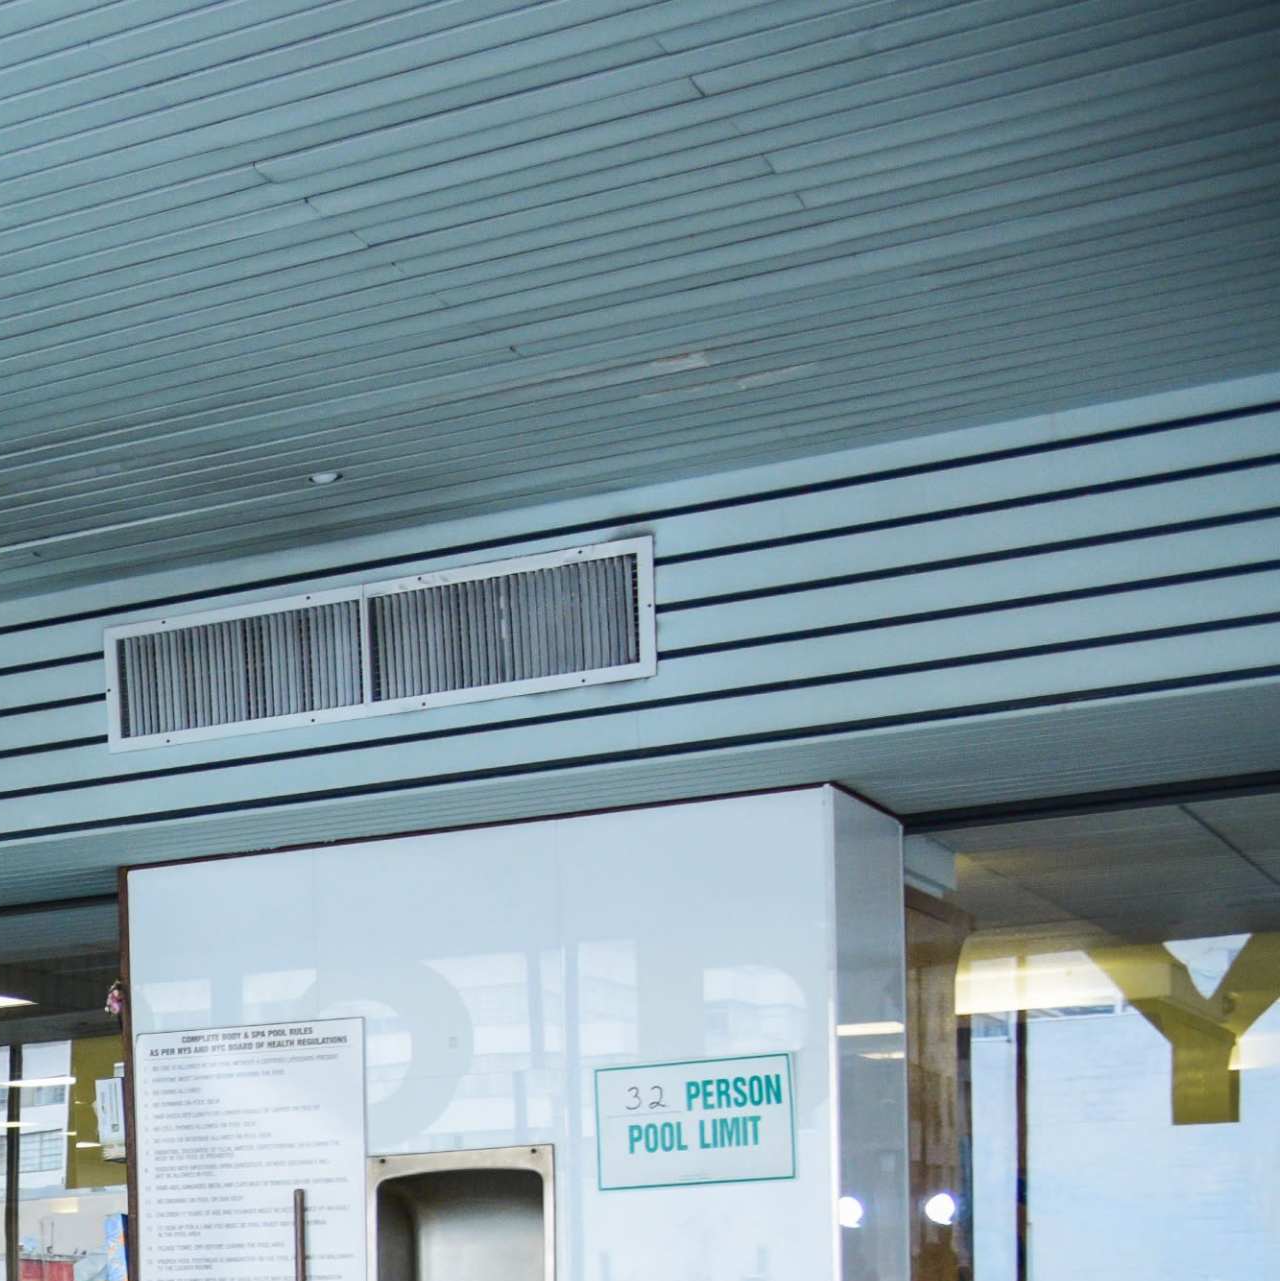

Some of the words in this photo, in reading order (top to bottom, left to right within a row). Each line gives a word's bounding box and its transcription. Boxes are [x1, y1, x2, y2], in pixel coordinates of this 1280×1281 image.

[149, 1049, 159, 1057] AS
[160, 1048, 176, 1056] PER
[177, 1047, 192, 1055] NYS
[193, 1045, 209, 1053] AND
[211, 1044, 226, 1052] NYC
[228, 1042, 253, 1051] BOARD
[255, 1041, 264, 1049] OF
[267, 1039, 295, 1048] HEALTH
[297, 1036, 348, 1046] REGULATIONS
[181, 1033, 219, 1044] COMPLETE
[222, 1032, 241, 1041] BODY
[251, 1030, 266, 1038] SPA
[268, 1029, 287, 1037] POOL
[289, 1027, 313, 1036] RULES
[624, 1084, 670, 1111] 32
[685, 1073, 783, 1112] PERSON
[628, 1121, 689, 1155] POOL
[699, 1115, 762, 1150] LIMIT
